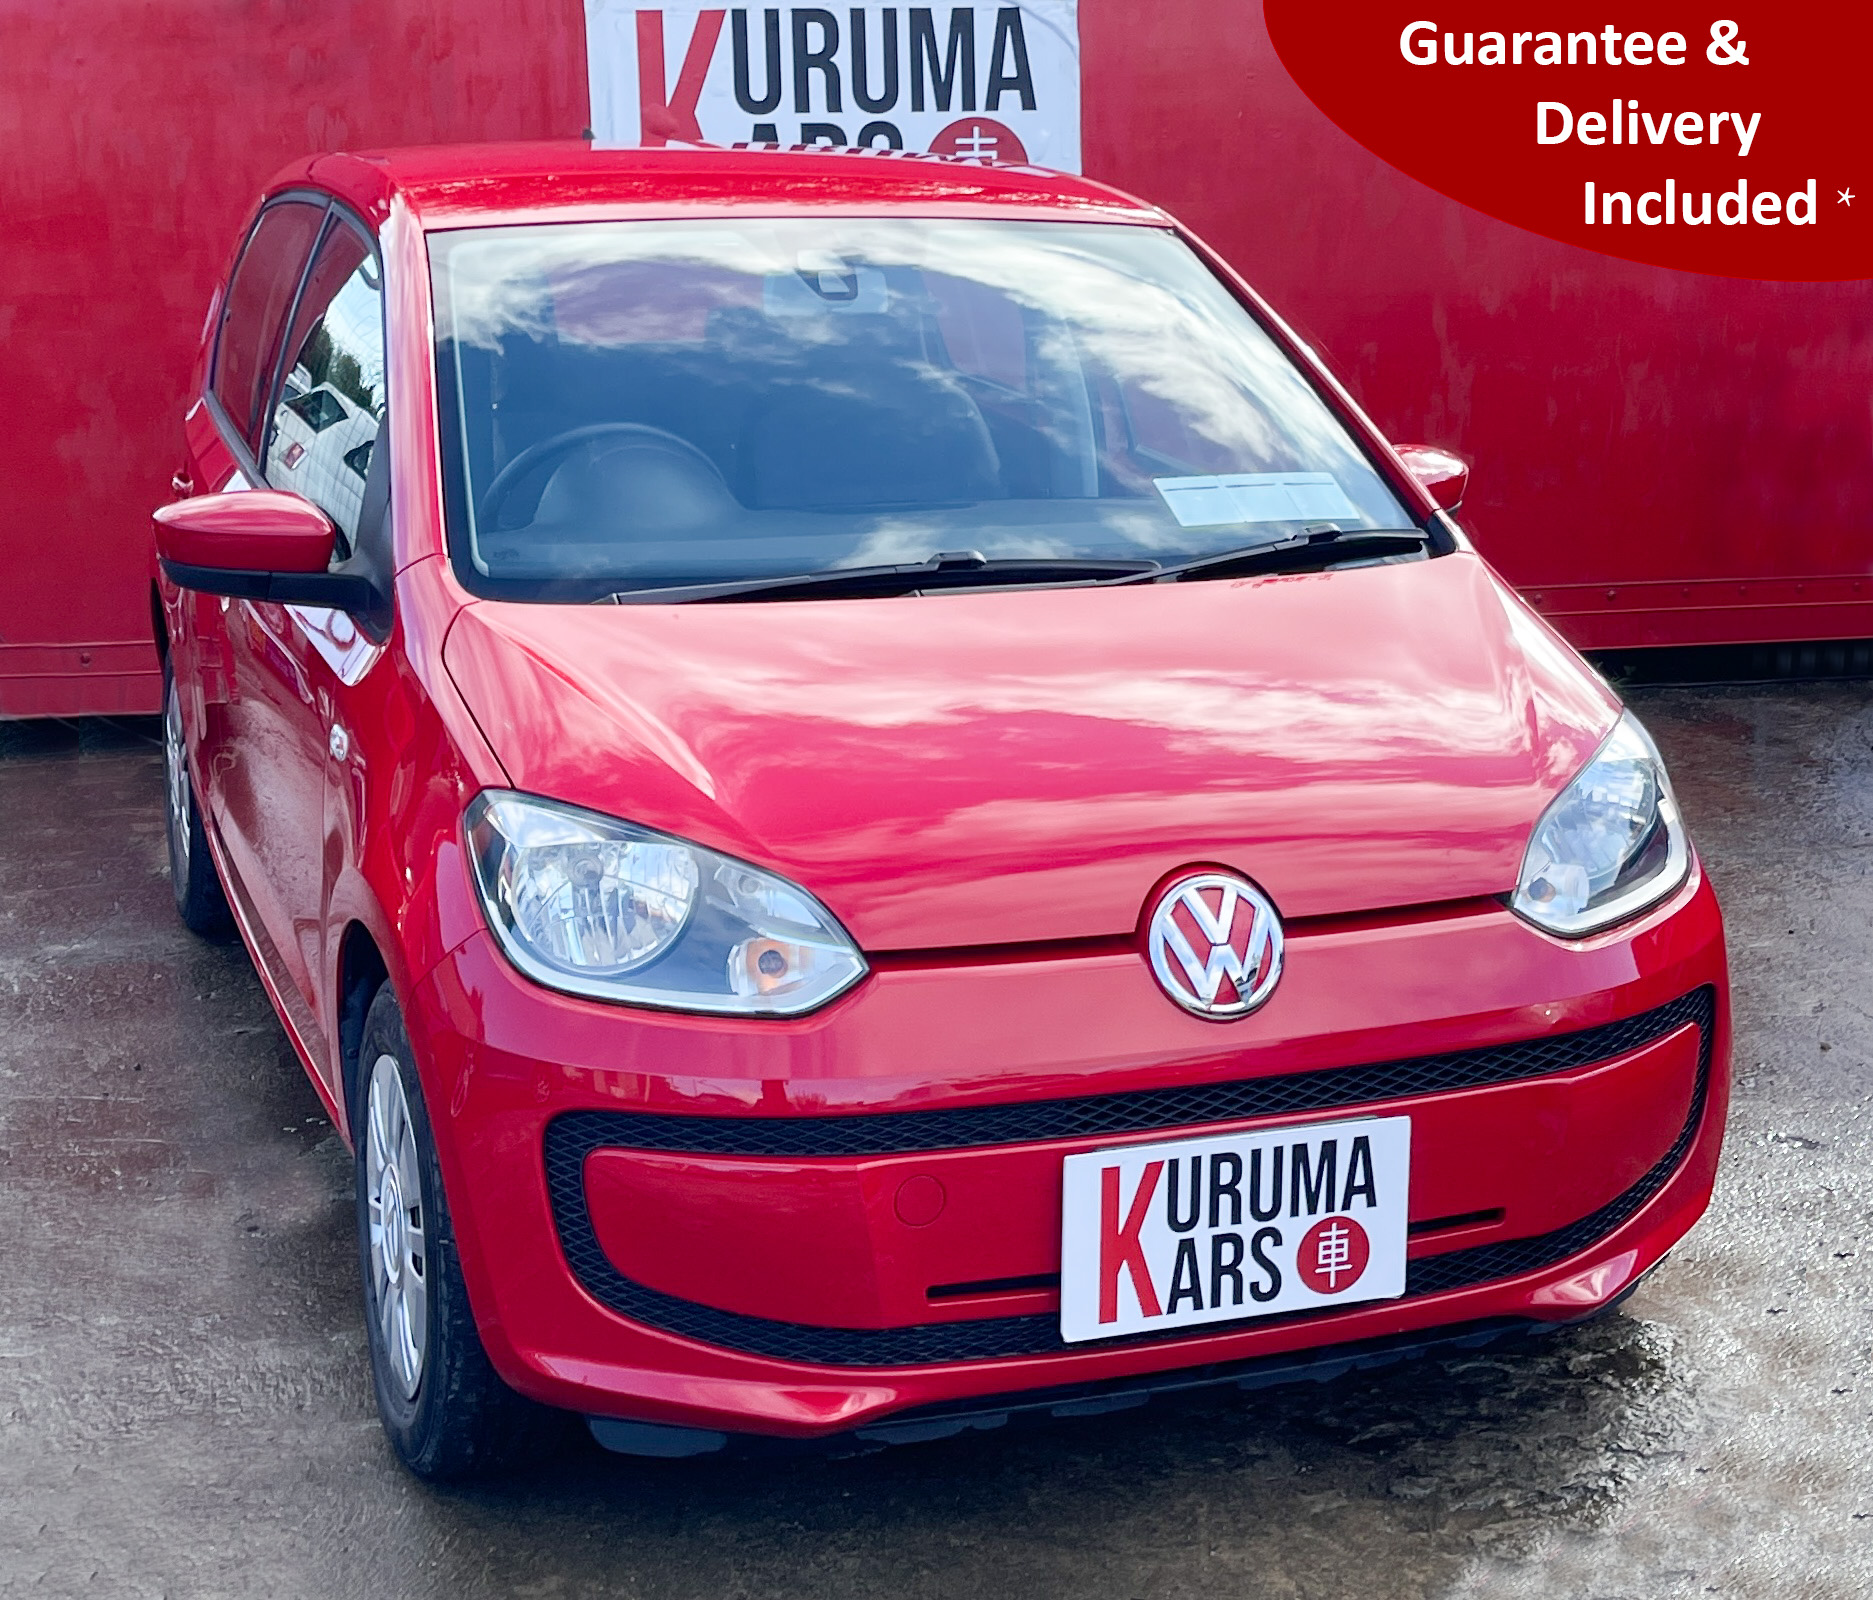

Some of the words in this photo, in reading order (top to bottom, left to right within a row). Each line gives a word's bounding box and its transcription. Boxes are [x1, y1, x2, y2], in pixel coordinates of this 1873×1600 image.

[635, 7, 1037, 148] KURUMA
[1156, 879, 1275, 1010] VW
[1098, 1135, 1378, 1325] KURUMA
[1314, 1222, 1354, 1288] 車
